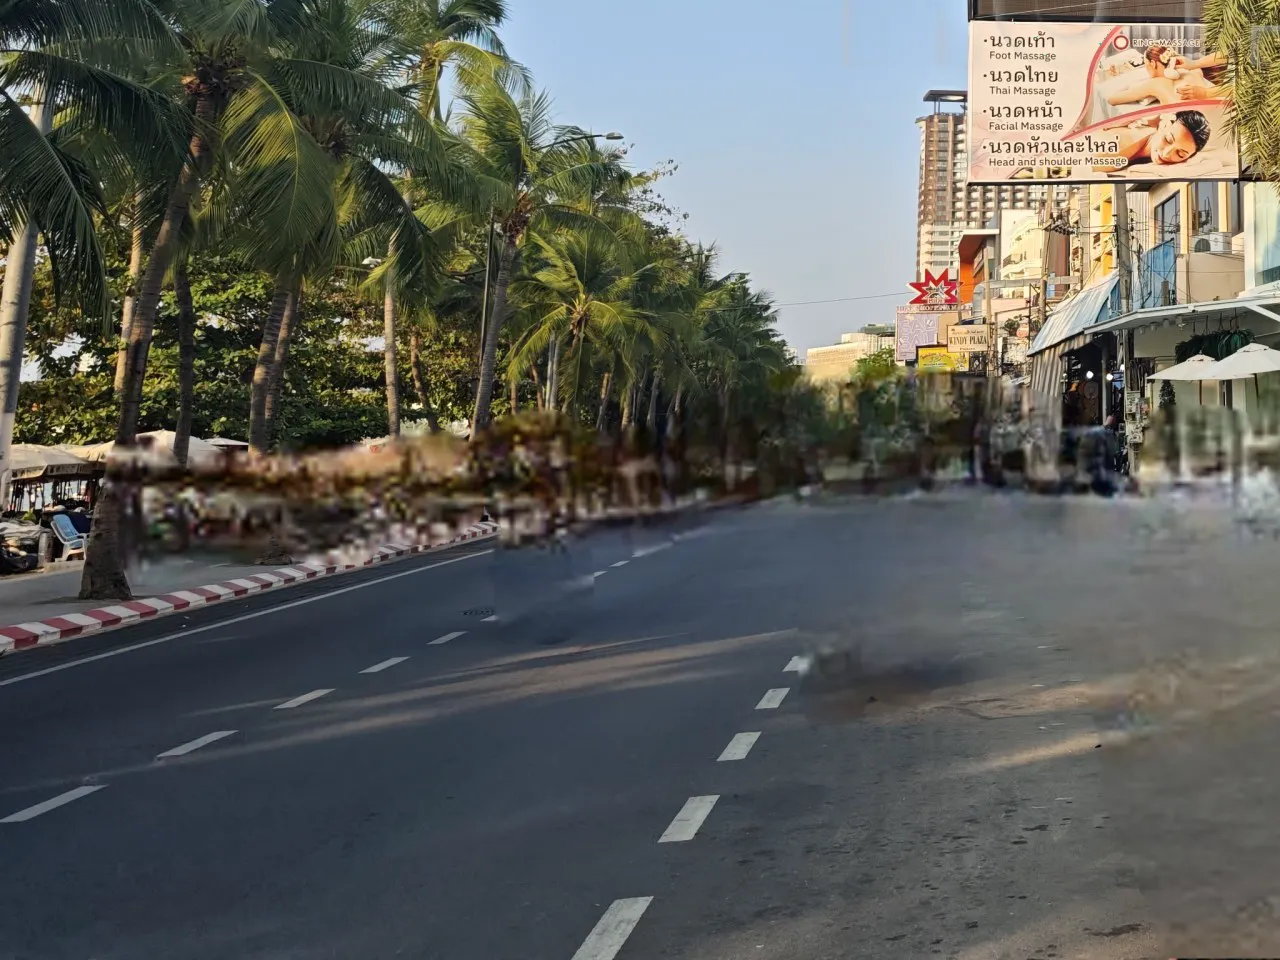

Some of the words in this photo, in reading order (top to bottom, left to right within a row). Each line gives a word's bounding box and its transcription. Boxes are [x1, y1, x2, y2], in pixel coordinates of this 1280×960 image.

[990, 31, 1055, 48] นวดเท้า
[1133, 39, 1153, 47] RING
[1160, 39, 1200, 47] MASSAGE
[990, 51, 1011, 60] Foot
[1014, 51, 1057, 62] Massage
[990, 65, 1058, 82] นวดไทย
[990, 86, 1011, 95] Thai
[1014, 86, 1056, 97] Massage
[989, 100, 1062, 118] นวดหน้า
[989, 121, 1018, 131] Facial
[1021, 121, 1063, 132] Massage
[989, 135, 1118, 154] นวดหัวและไหล่
[989, 158, 1015, 166] Head
[1017, 158, 1036, 166] and
[1040, 157, 1082, 166] shoulder
[1085, 156, 1127, 168] Massage
[969, 335, 987, 345] PLAZA
